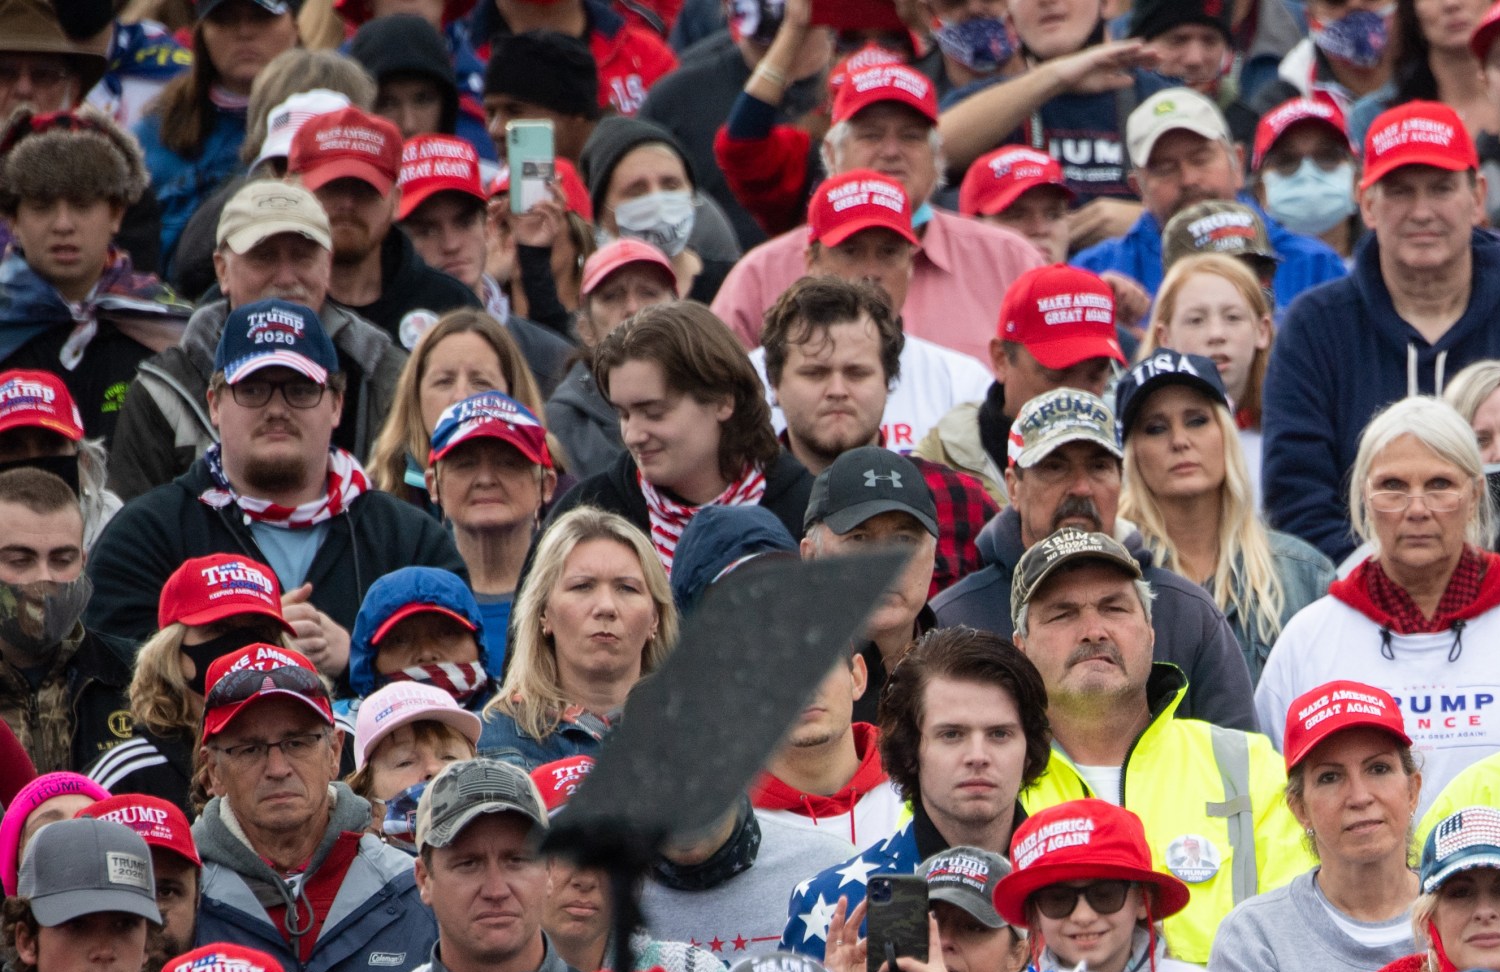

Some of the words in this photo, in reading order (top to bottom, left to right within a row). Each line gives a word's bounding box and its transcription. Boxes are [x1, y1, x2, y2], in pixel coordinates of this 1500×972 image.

[343, 126, 385, 146] AMERICA
[1371, 124, 1399, 150] MAKE
[1401, 118, 1454, 141] AMERICA
[319, 139, 351, 152] GREAT
[419, 141, 474, 162] AMERICA
[397, 162, 431, 185] REAT
[432, 160, 471, 180] AGAIN
[1037, 294, 1072, 313] MAKE
[246, 311, 304, 338] Trump
[1044, 307, 1083, 325] GREAT
[254, 330, 295, 345] 2020
[1132, 353, 1201, 387] USA
[0, 382, 56, 405] rump
[1024, 397, 1107, 428] TRUMP
[1046, 552, 1058, 562] NO
[202, 562, 273, 596] Trump
[209, 590, 233, 600] KEEPING
[234, 588, 259, 598] AMERICA
[1298, 694, 1330, 721] MAKE
[1332, 690, 1386, 709] AMERICA
[1393, 693, 1494, 713] UMP
[1305, 703, 1342, 730] GREAT
[1347, 702, 1382, 716] AGAIN
[1417, 715, 1481, 729] NCE
[30, 781, 85, 806] TRUMP
[150, 830, 173, 840] GREAT
[1013, 836, 1036, 862] MAKE
[1037, 817, 1094, 844] AMERICA
[1018, 844, 1046, 870] GREAT
[1047, 832, 1090, 852] AGAIN
[112, 856, 146, 869] TRUMP
[928, 855, 989, 876] Trump
[948, 866, 976, 877] 2020
[119, 868, 143, 880] 2020
